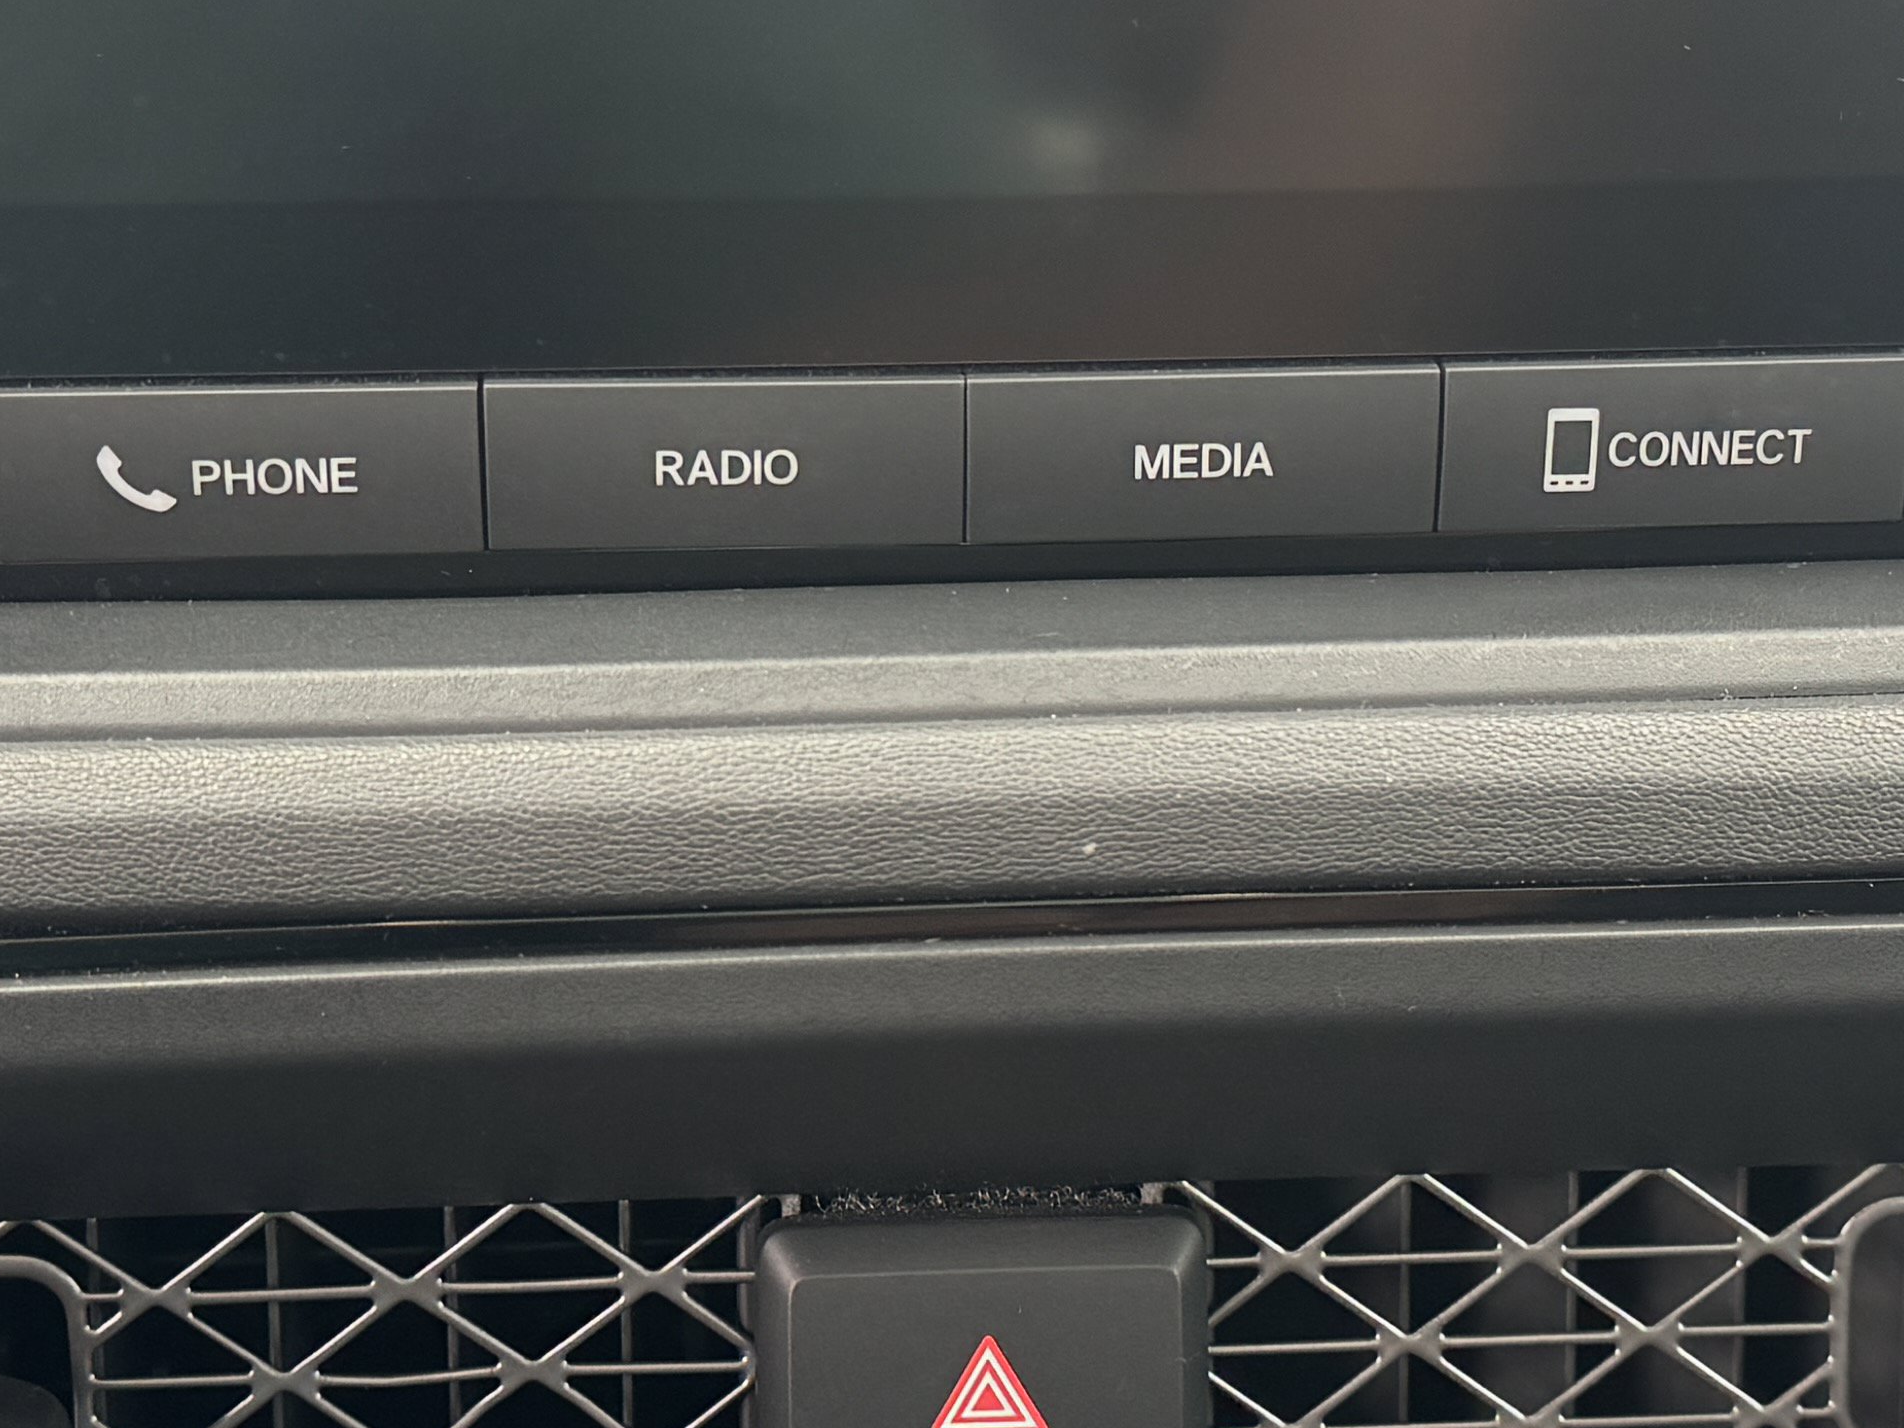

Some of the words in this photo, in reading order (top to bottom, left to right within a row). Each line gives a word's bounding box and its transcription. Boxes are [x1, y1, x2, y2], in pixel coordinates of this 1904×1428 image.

[654, 448, 800, 487] RADIO
[1132, 441, 1274, 481] MEDIA
[1607, 428, 1812, 469] CONNECT
[190, 456, 360, 497] PHONE
